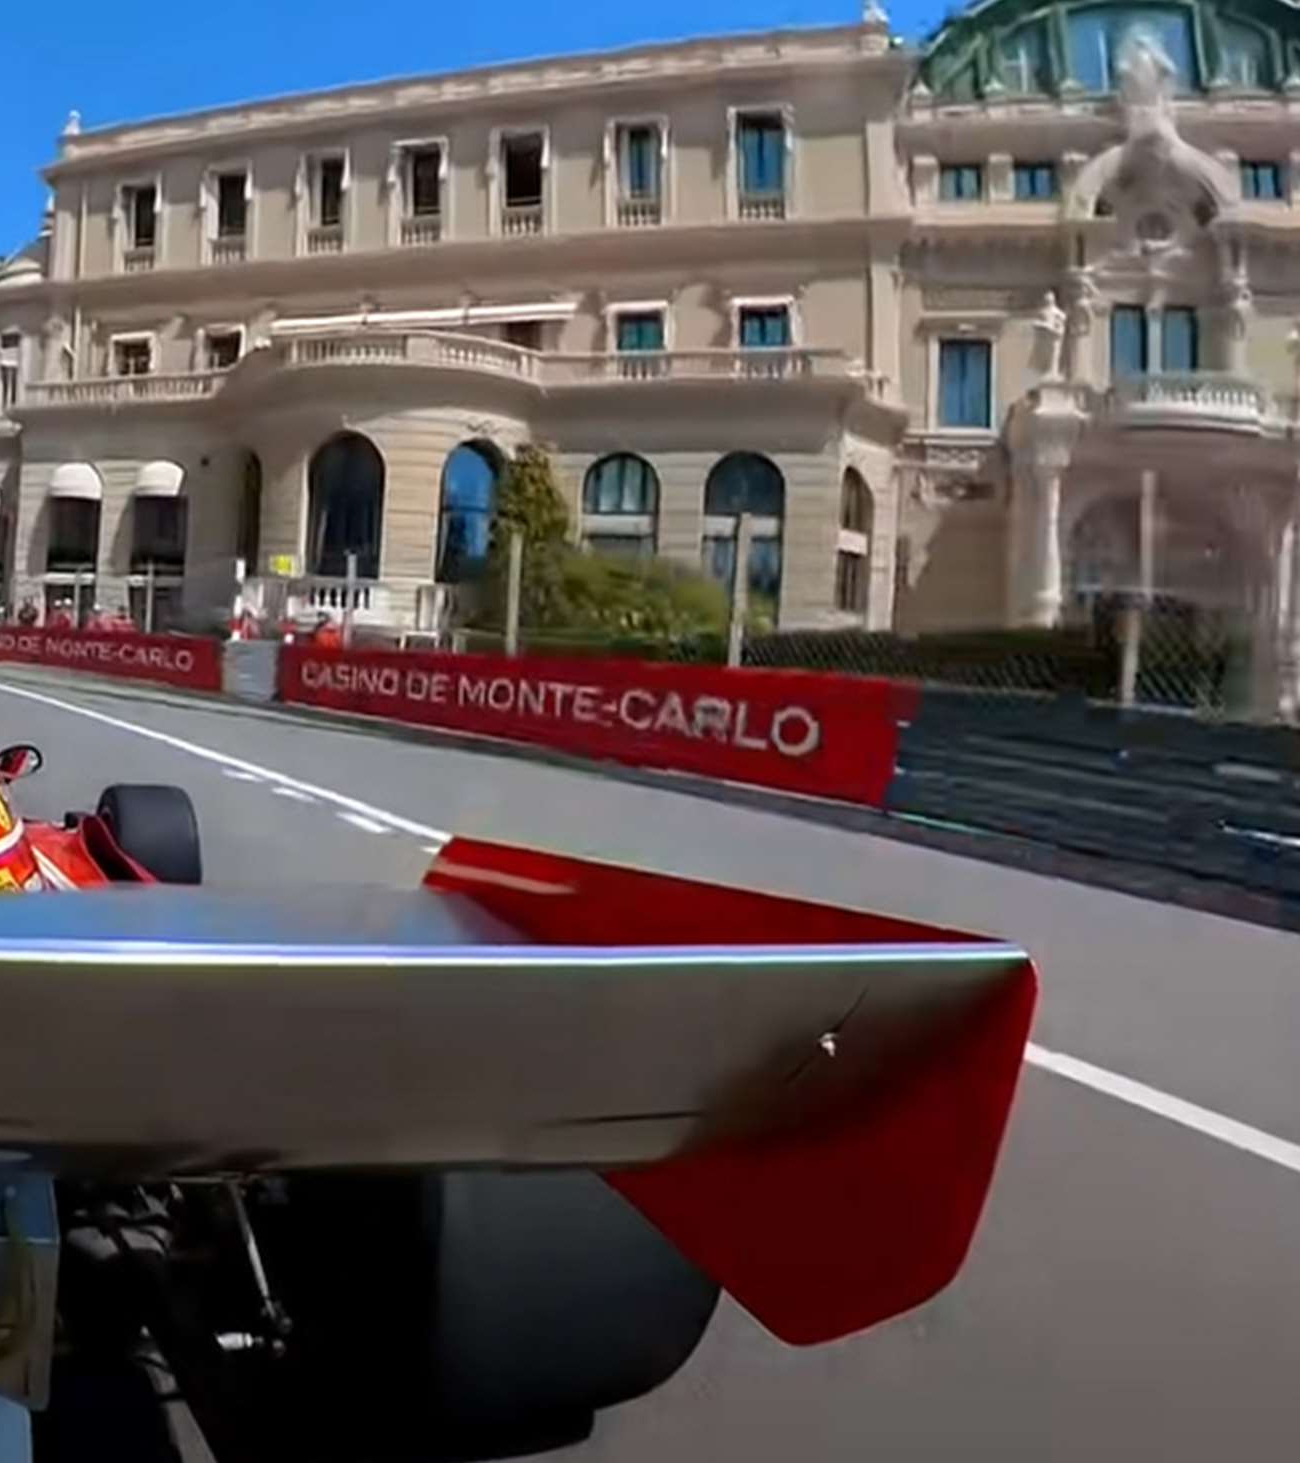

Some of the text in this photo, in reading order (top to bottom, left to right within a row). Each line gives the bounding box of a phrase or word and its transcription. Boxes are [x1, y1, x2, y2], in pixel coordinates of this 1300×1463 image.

[18, 636, 41, 655] DE
[45, 637, 195, 672] MONTE-CARLO
[301, 661, 820, 756] CASINO DE MONTE-CARLO
